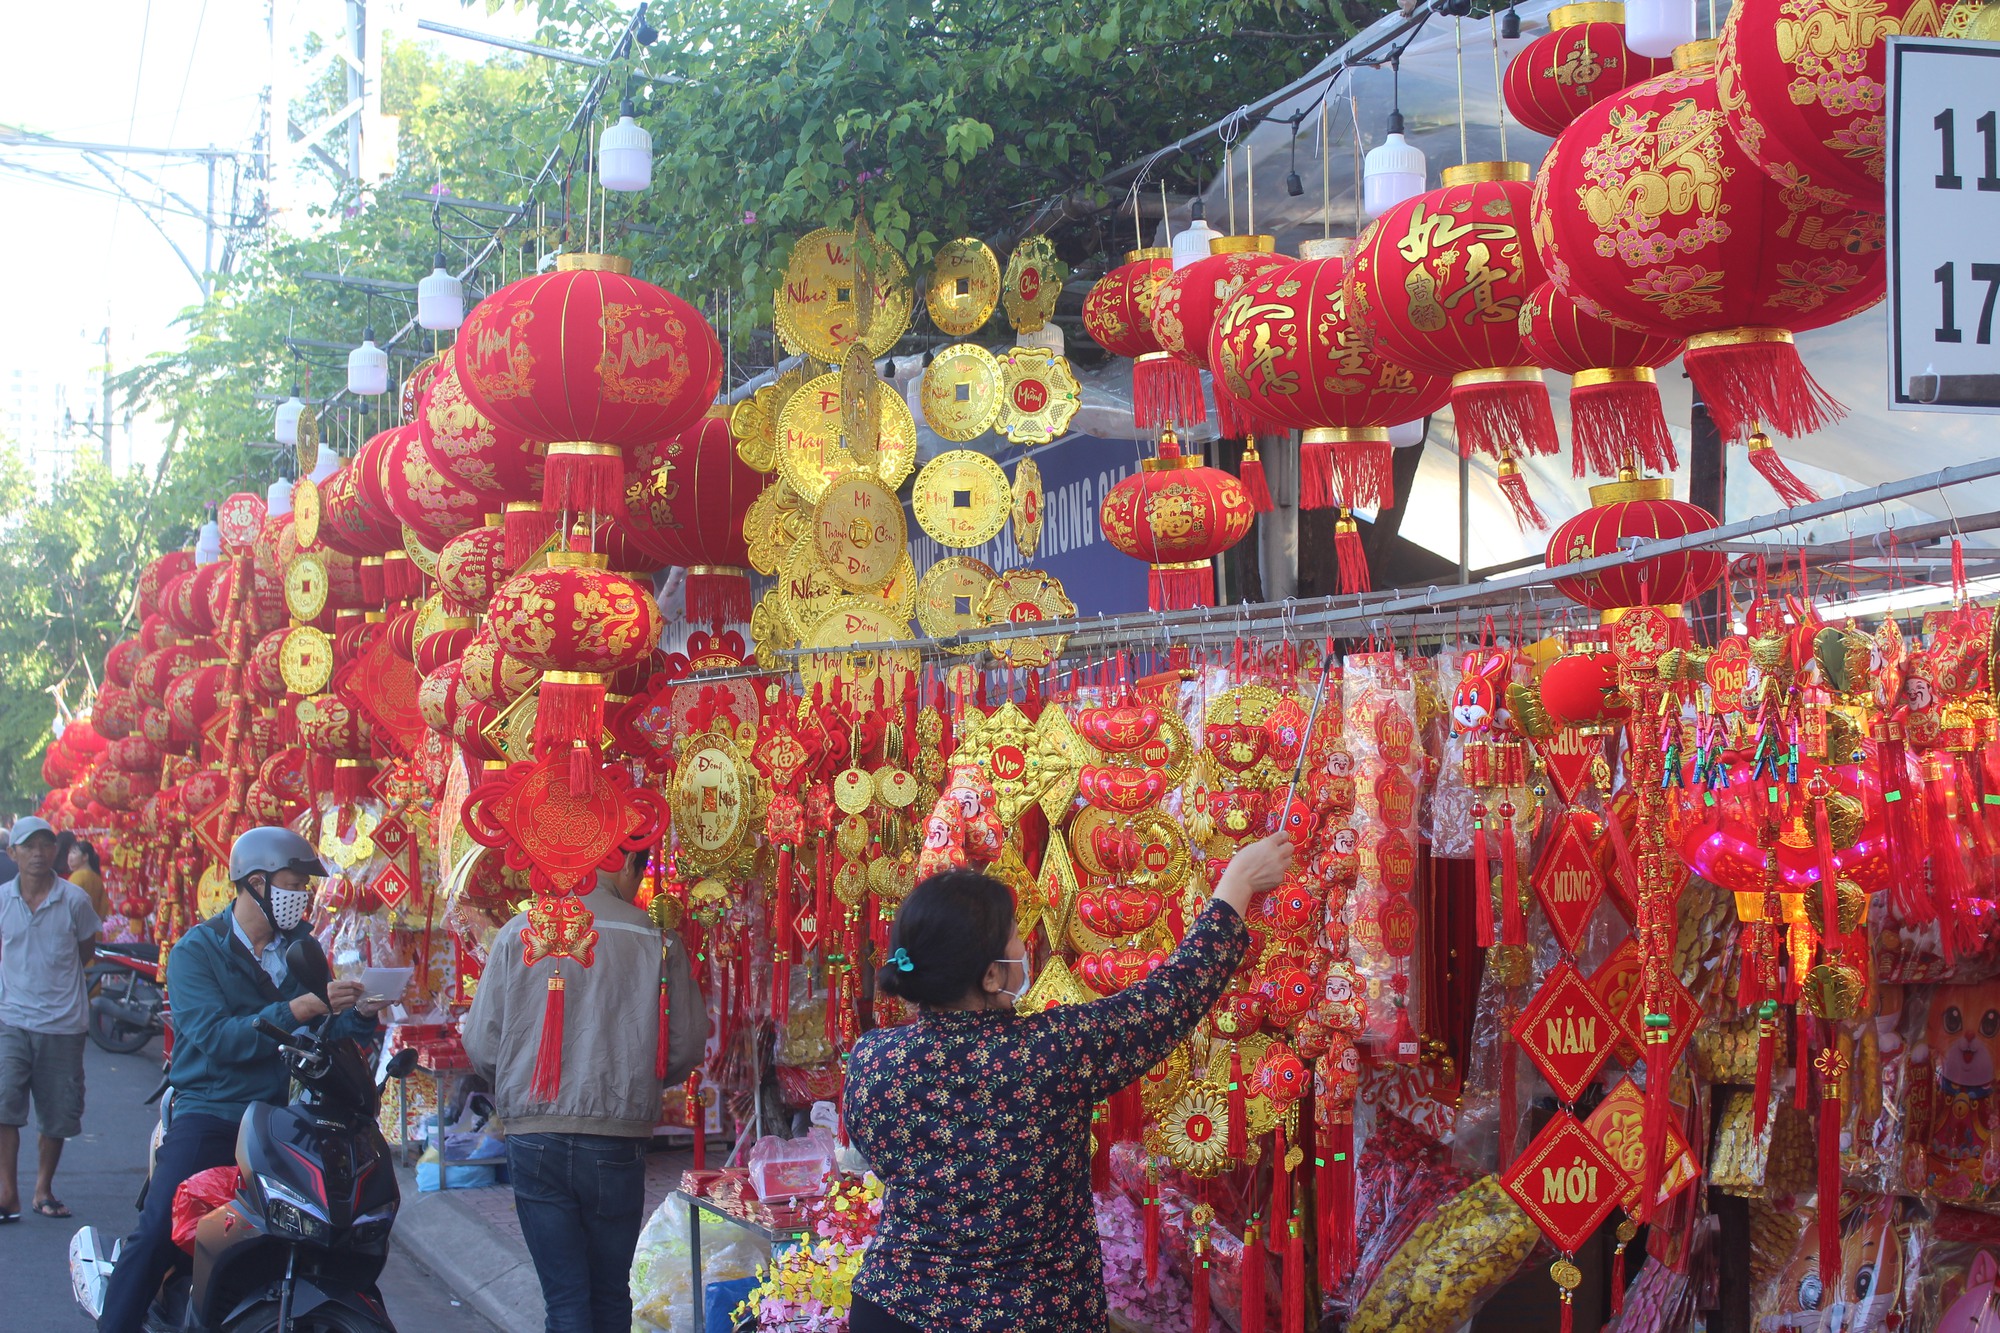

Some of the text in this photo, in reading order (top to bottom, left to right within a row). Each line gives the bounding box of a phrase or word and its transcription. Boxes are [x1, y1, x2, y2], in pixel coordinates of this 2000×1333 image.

[1115, 724, 1139, 744] 福
[1116, 787, 1139, 807] 福
[1553, 862, 1592, 904] MỪNG
[1546, 1005, 1596, 1055] NĂM
[1542, 1156, 1598, 1204] MỚI
